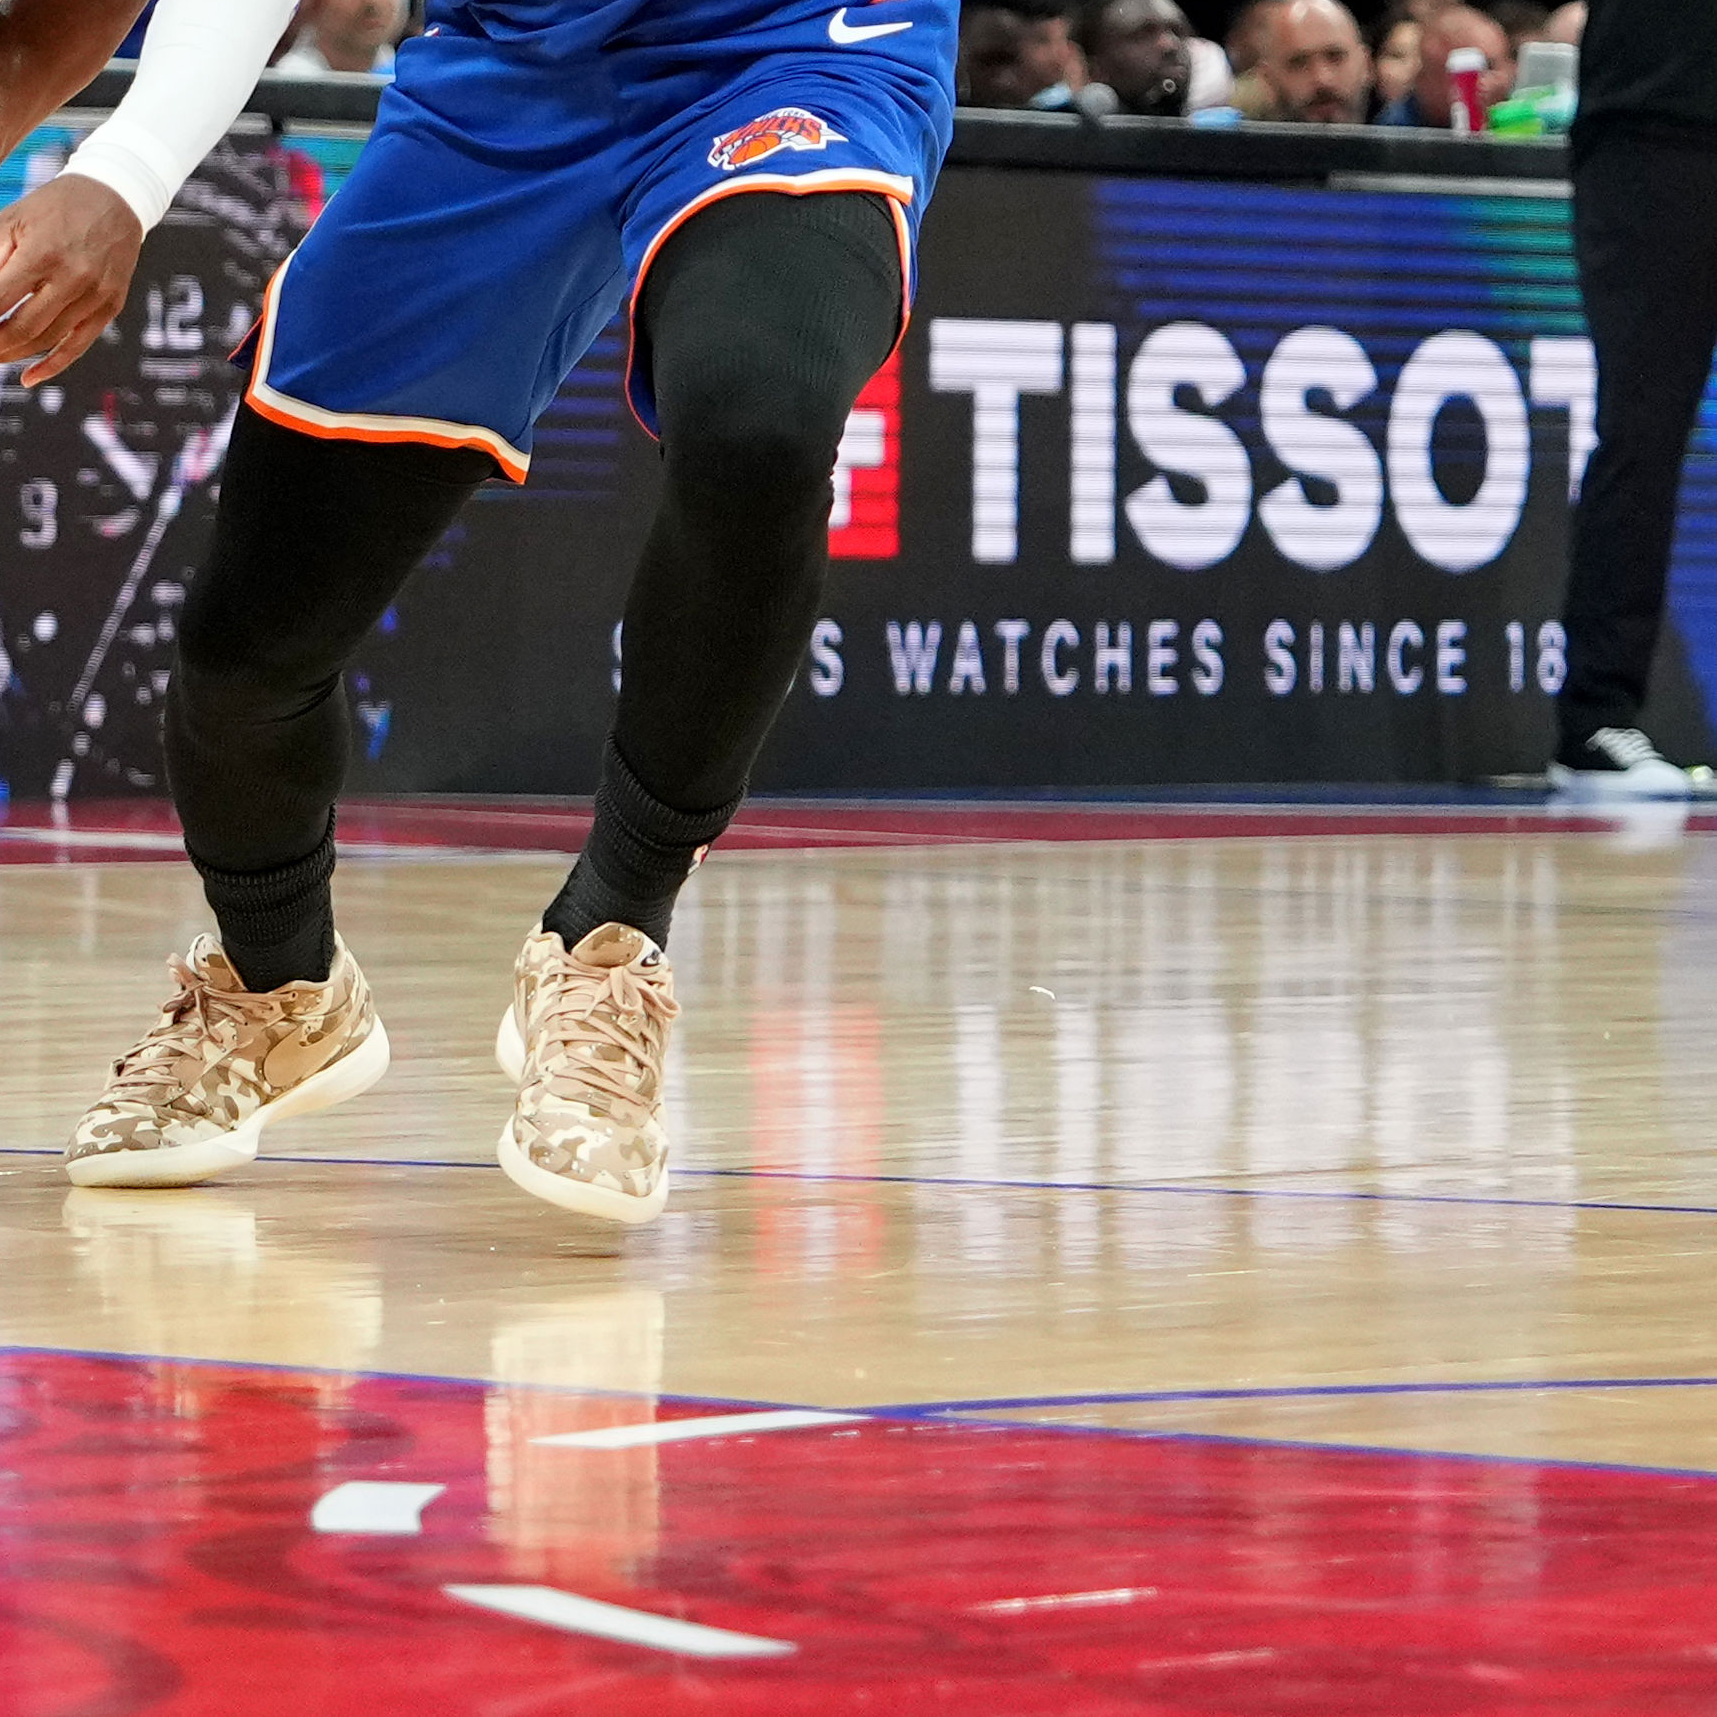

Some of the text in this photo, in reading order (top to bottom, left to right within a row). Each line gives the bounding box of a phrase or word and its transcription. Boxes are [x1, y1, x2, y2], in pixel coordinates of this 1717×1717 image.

[887, 616, 1225, 697] WATCHES
[1263, 617, 1468, 697] SINCE
[1504, 618, 1568, 696] 18
